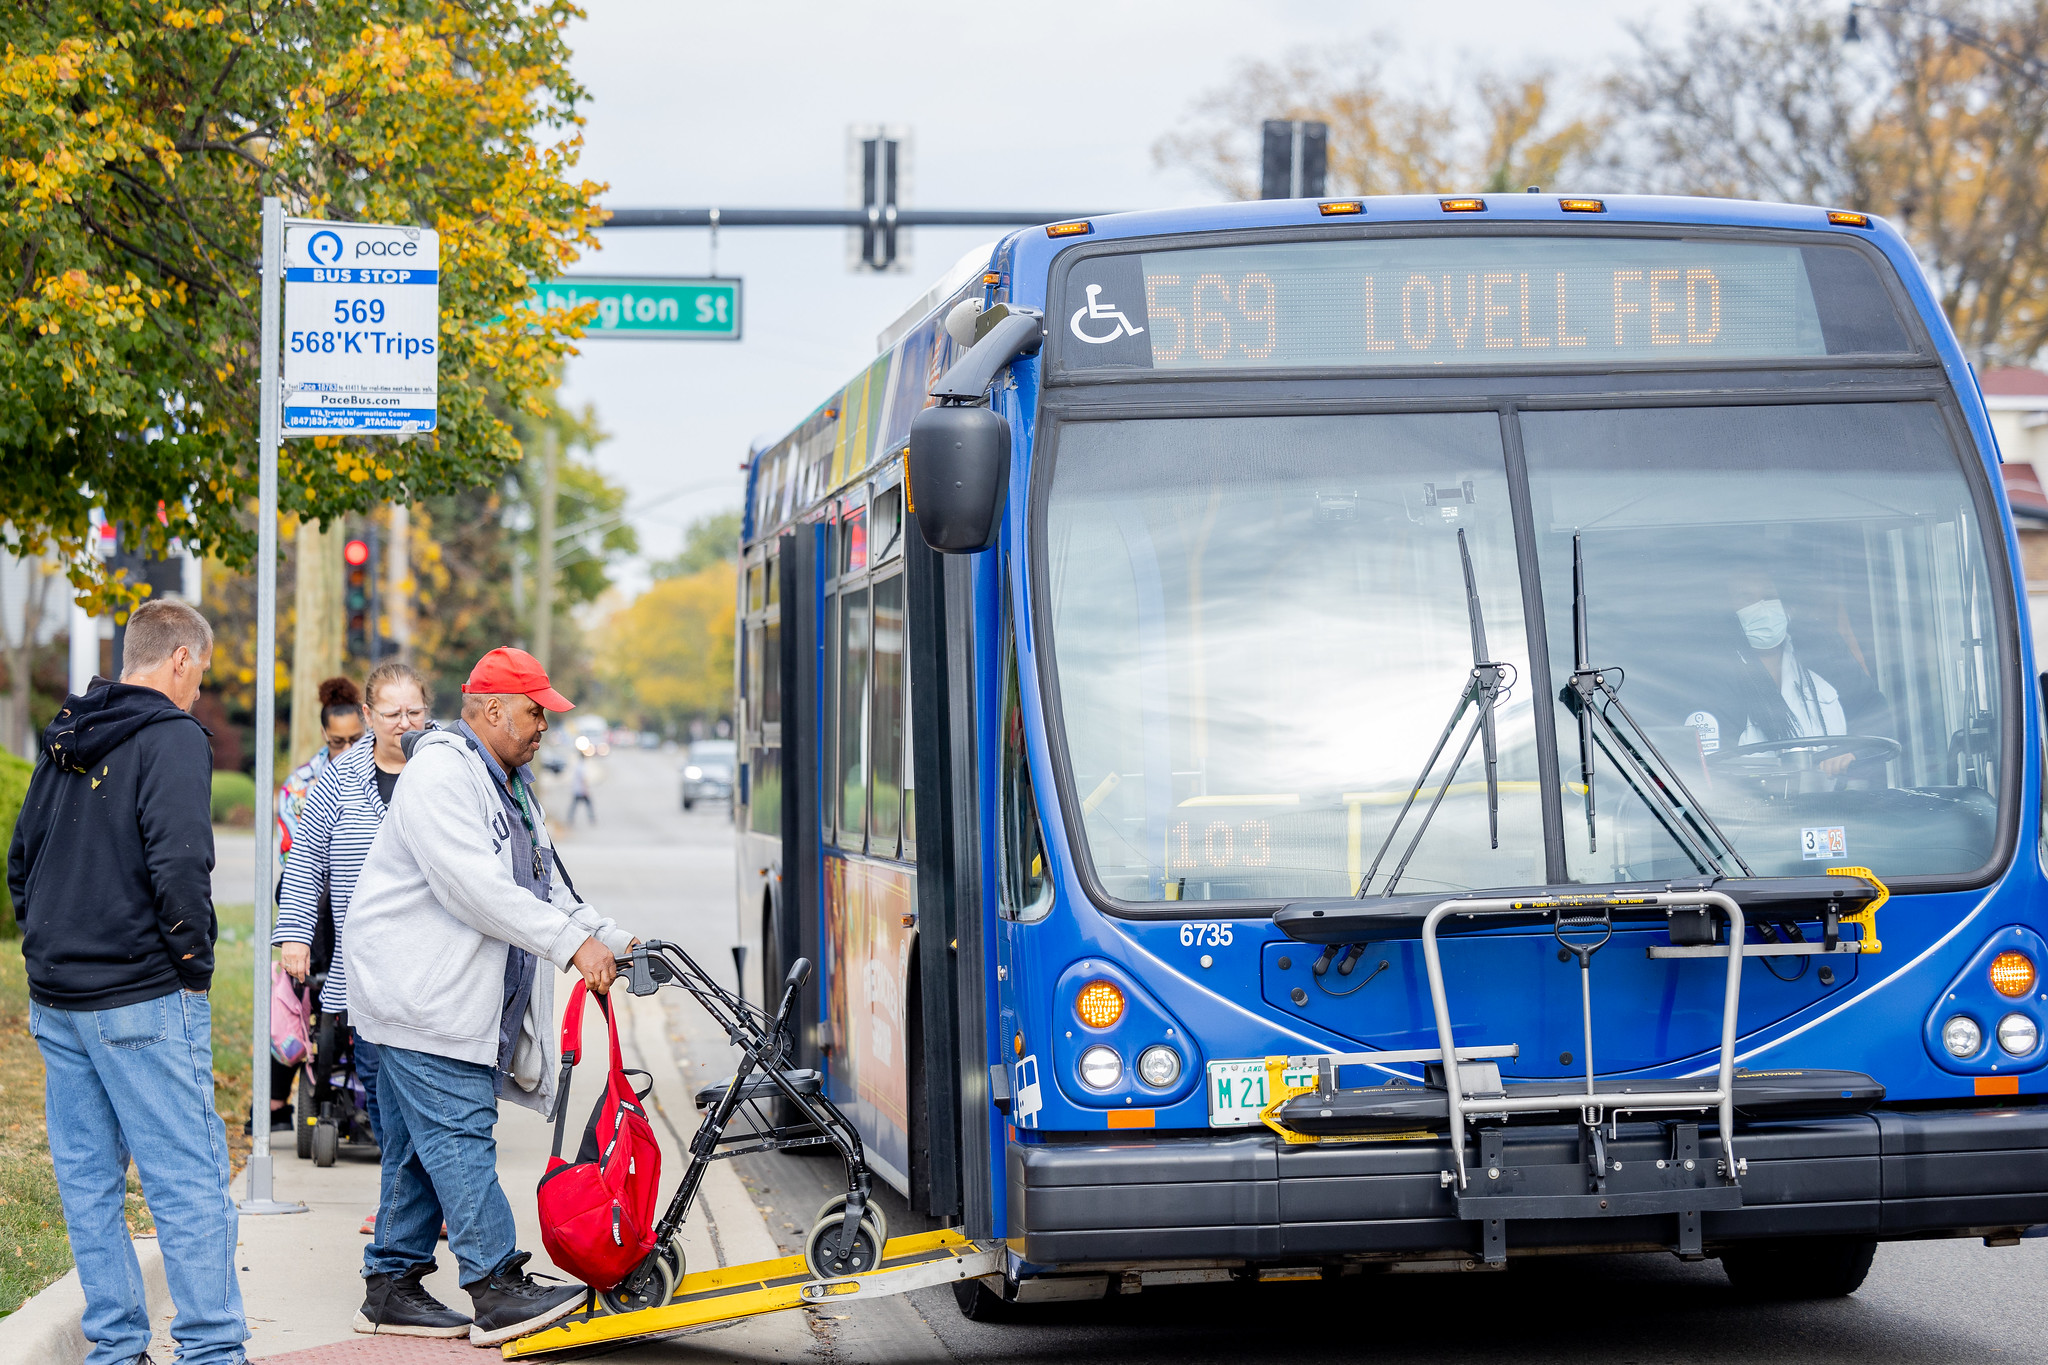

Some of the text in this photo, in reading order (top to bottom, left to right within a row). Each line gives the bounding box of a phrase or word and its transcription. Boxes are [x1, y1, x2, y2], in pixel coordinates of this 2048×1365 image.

[356, 241, 418, 259] pace
[313, 269, 411, 284] BUS STOP
[334, 299, 385, 324] 569
[695, 294, 728, 324] St
[1147, 269, 1721, 360] 569 LOVELL FED
[290, 331, 436, 360] 568'K'Trips
[321, 395, 401, 406] PaceBus.com
[347, 410, 387, 418] Information
[1172, 820, 1270, 868] 103
[1806, 831, 1843, 851] 3 25
[1179, 922, 1234, 947] 6735
[1218, 1078, 1232, 1108] M
